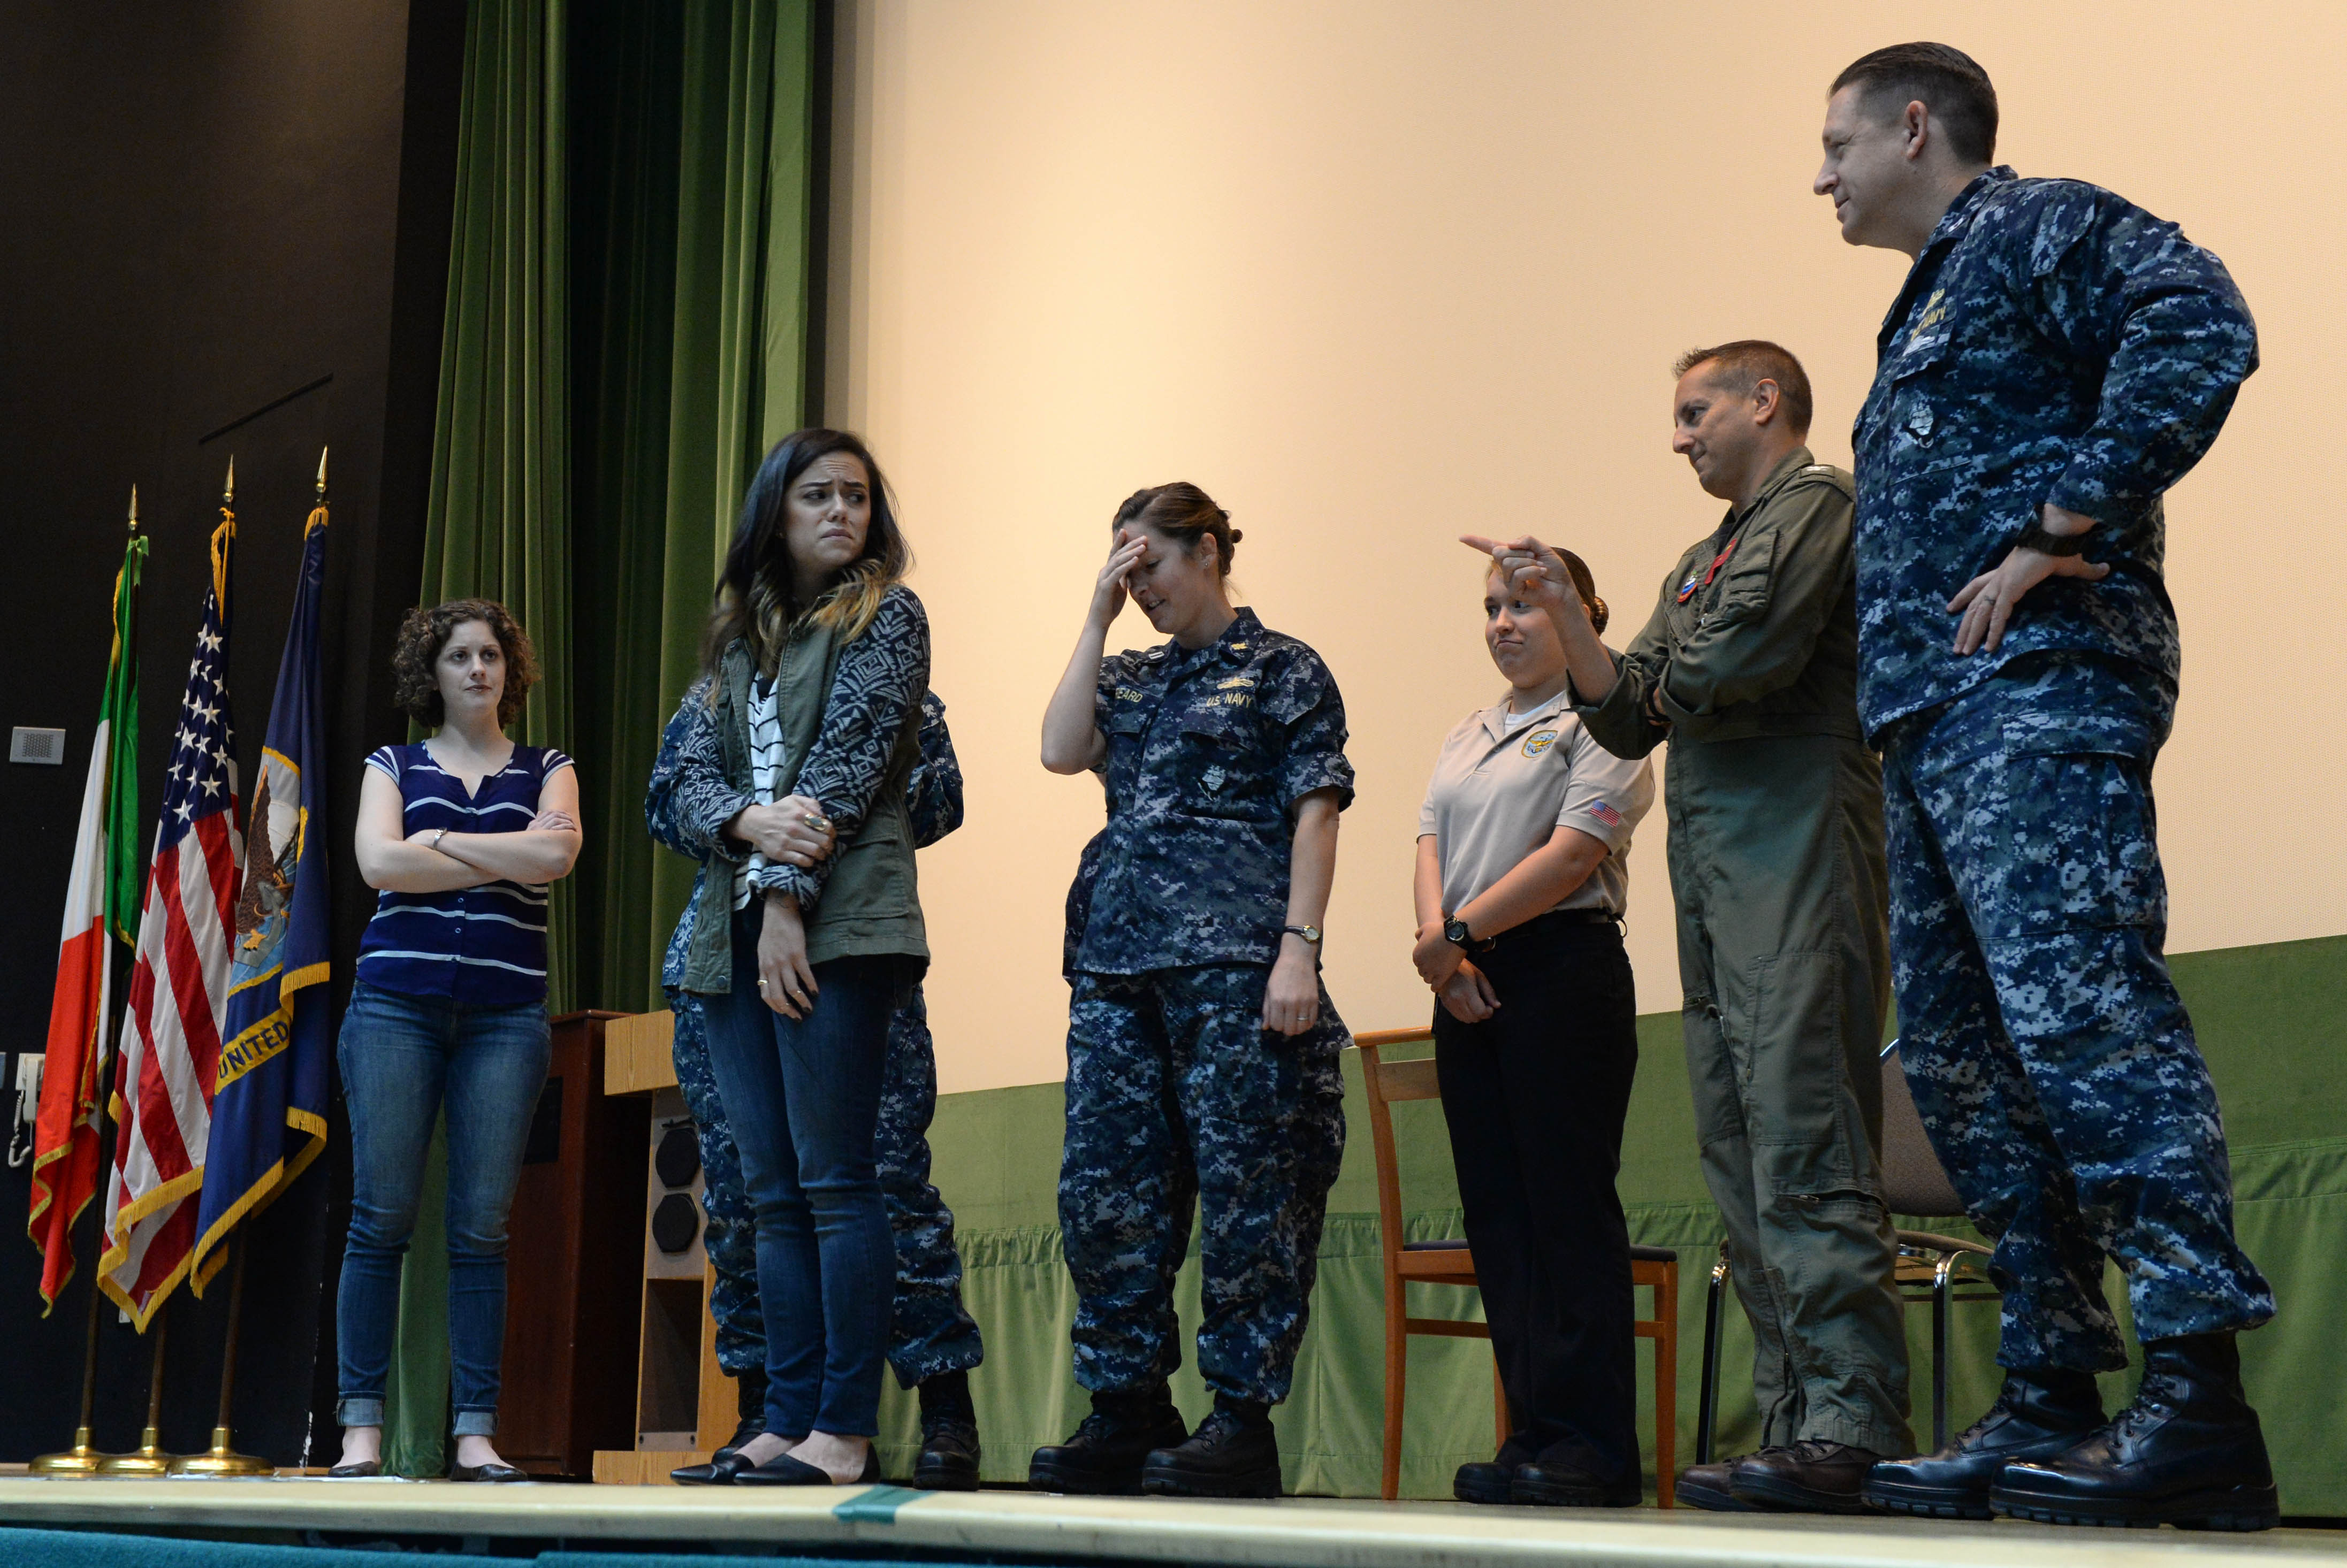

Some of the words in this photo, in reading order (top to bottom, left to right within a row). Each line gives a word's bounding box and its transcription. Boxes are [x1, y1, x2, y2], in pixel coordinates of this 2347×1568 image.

[1115, 687, 1144, 702] EARD
[1224, 692, 1252, 708] NAVY
[218, 1021, 289, 1079] UNITED
